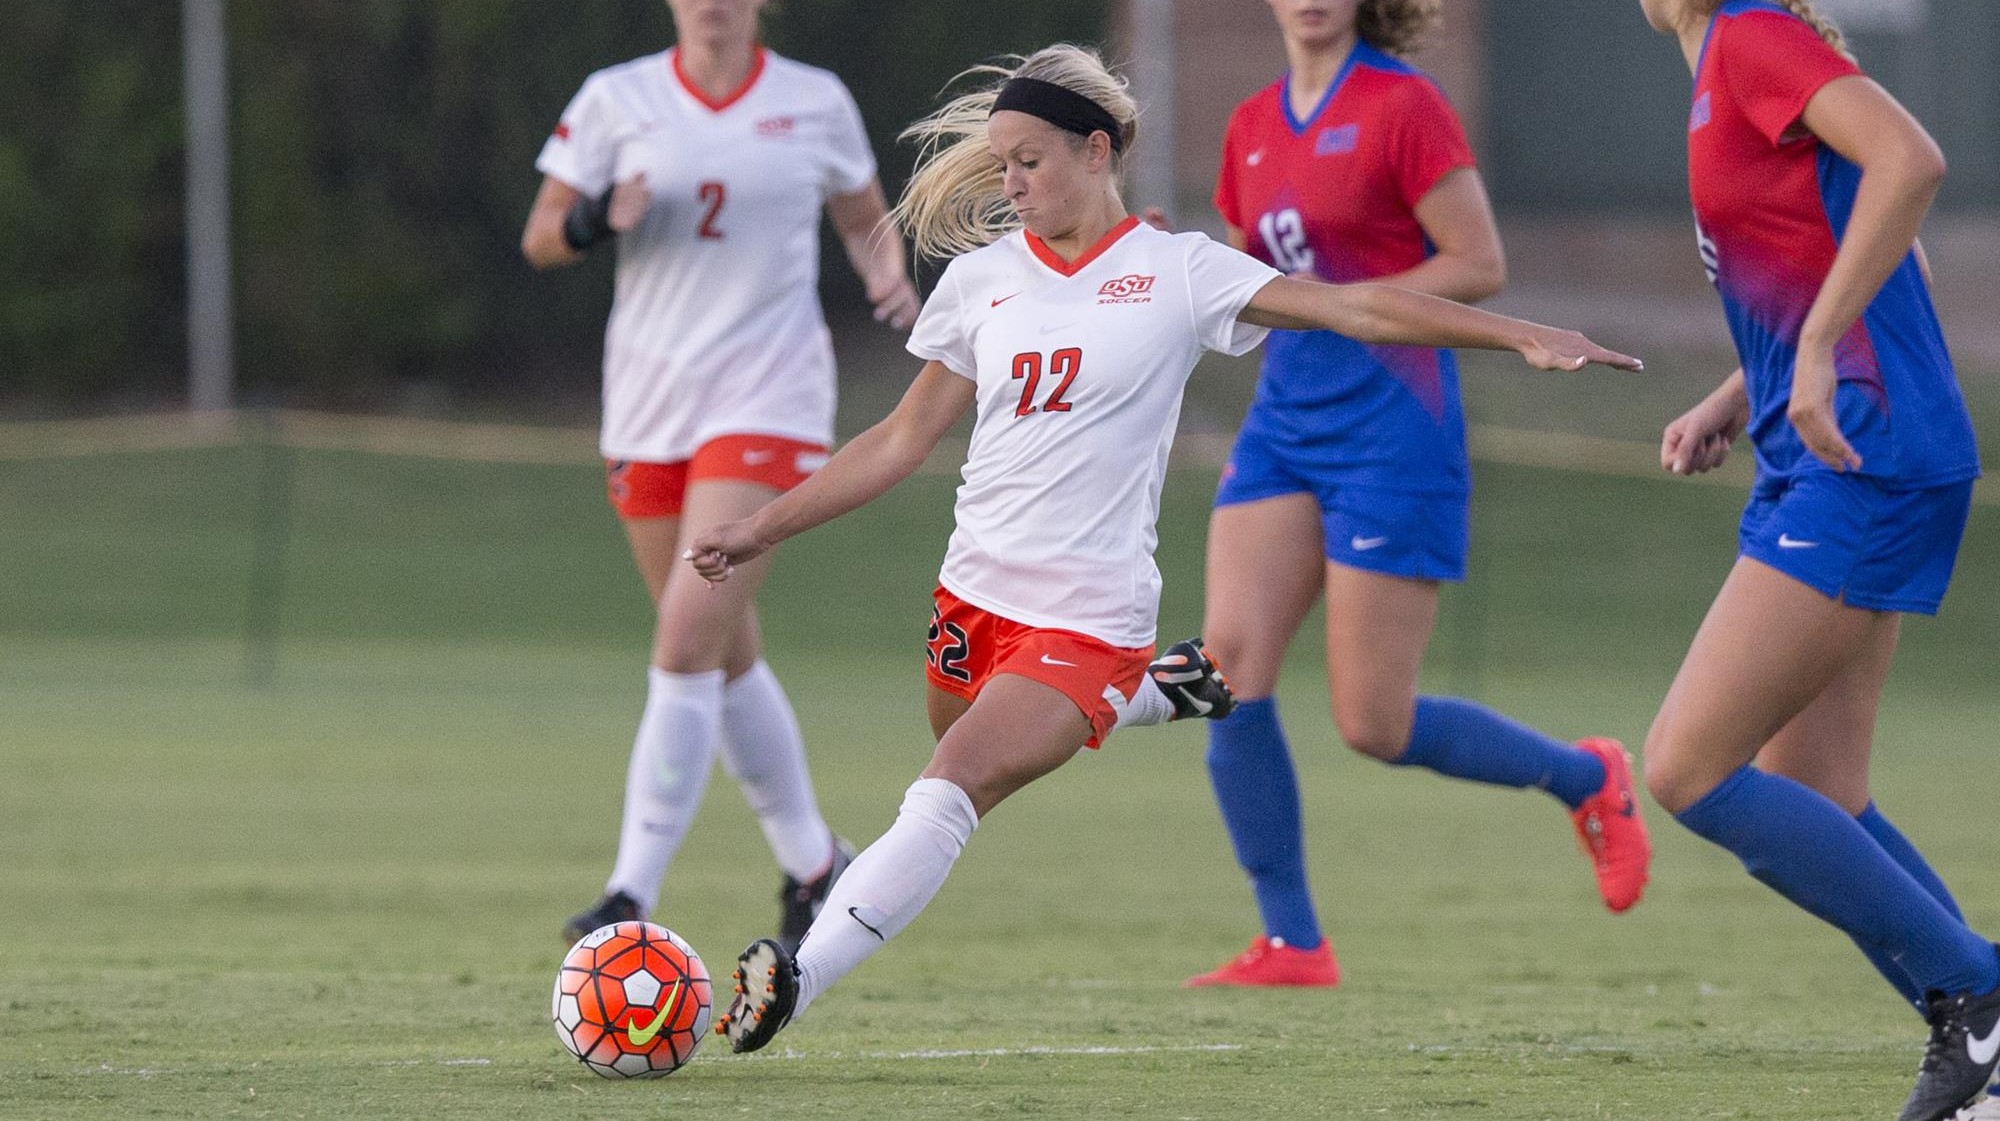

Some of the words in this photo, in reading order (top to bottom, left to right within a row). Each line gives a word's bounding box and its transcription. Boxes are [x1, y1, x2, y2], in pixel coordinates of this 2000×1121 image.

[699, 180, 726, 238] 2
[1259, 208, 1314, 271] 12
[1096, 297, 1151, 305] SOCCER
[1097, 274, 1155, 297] OSU
[1012, 347, 1083, 418] 22
